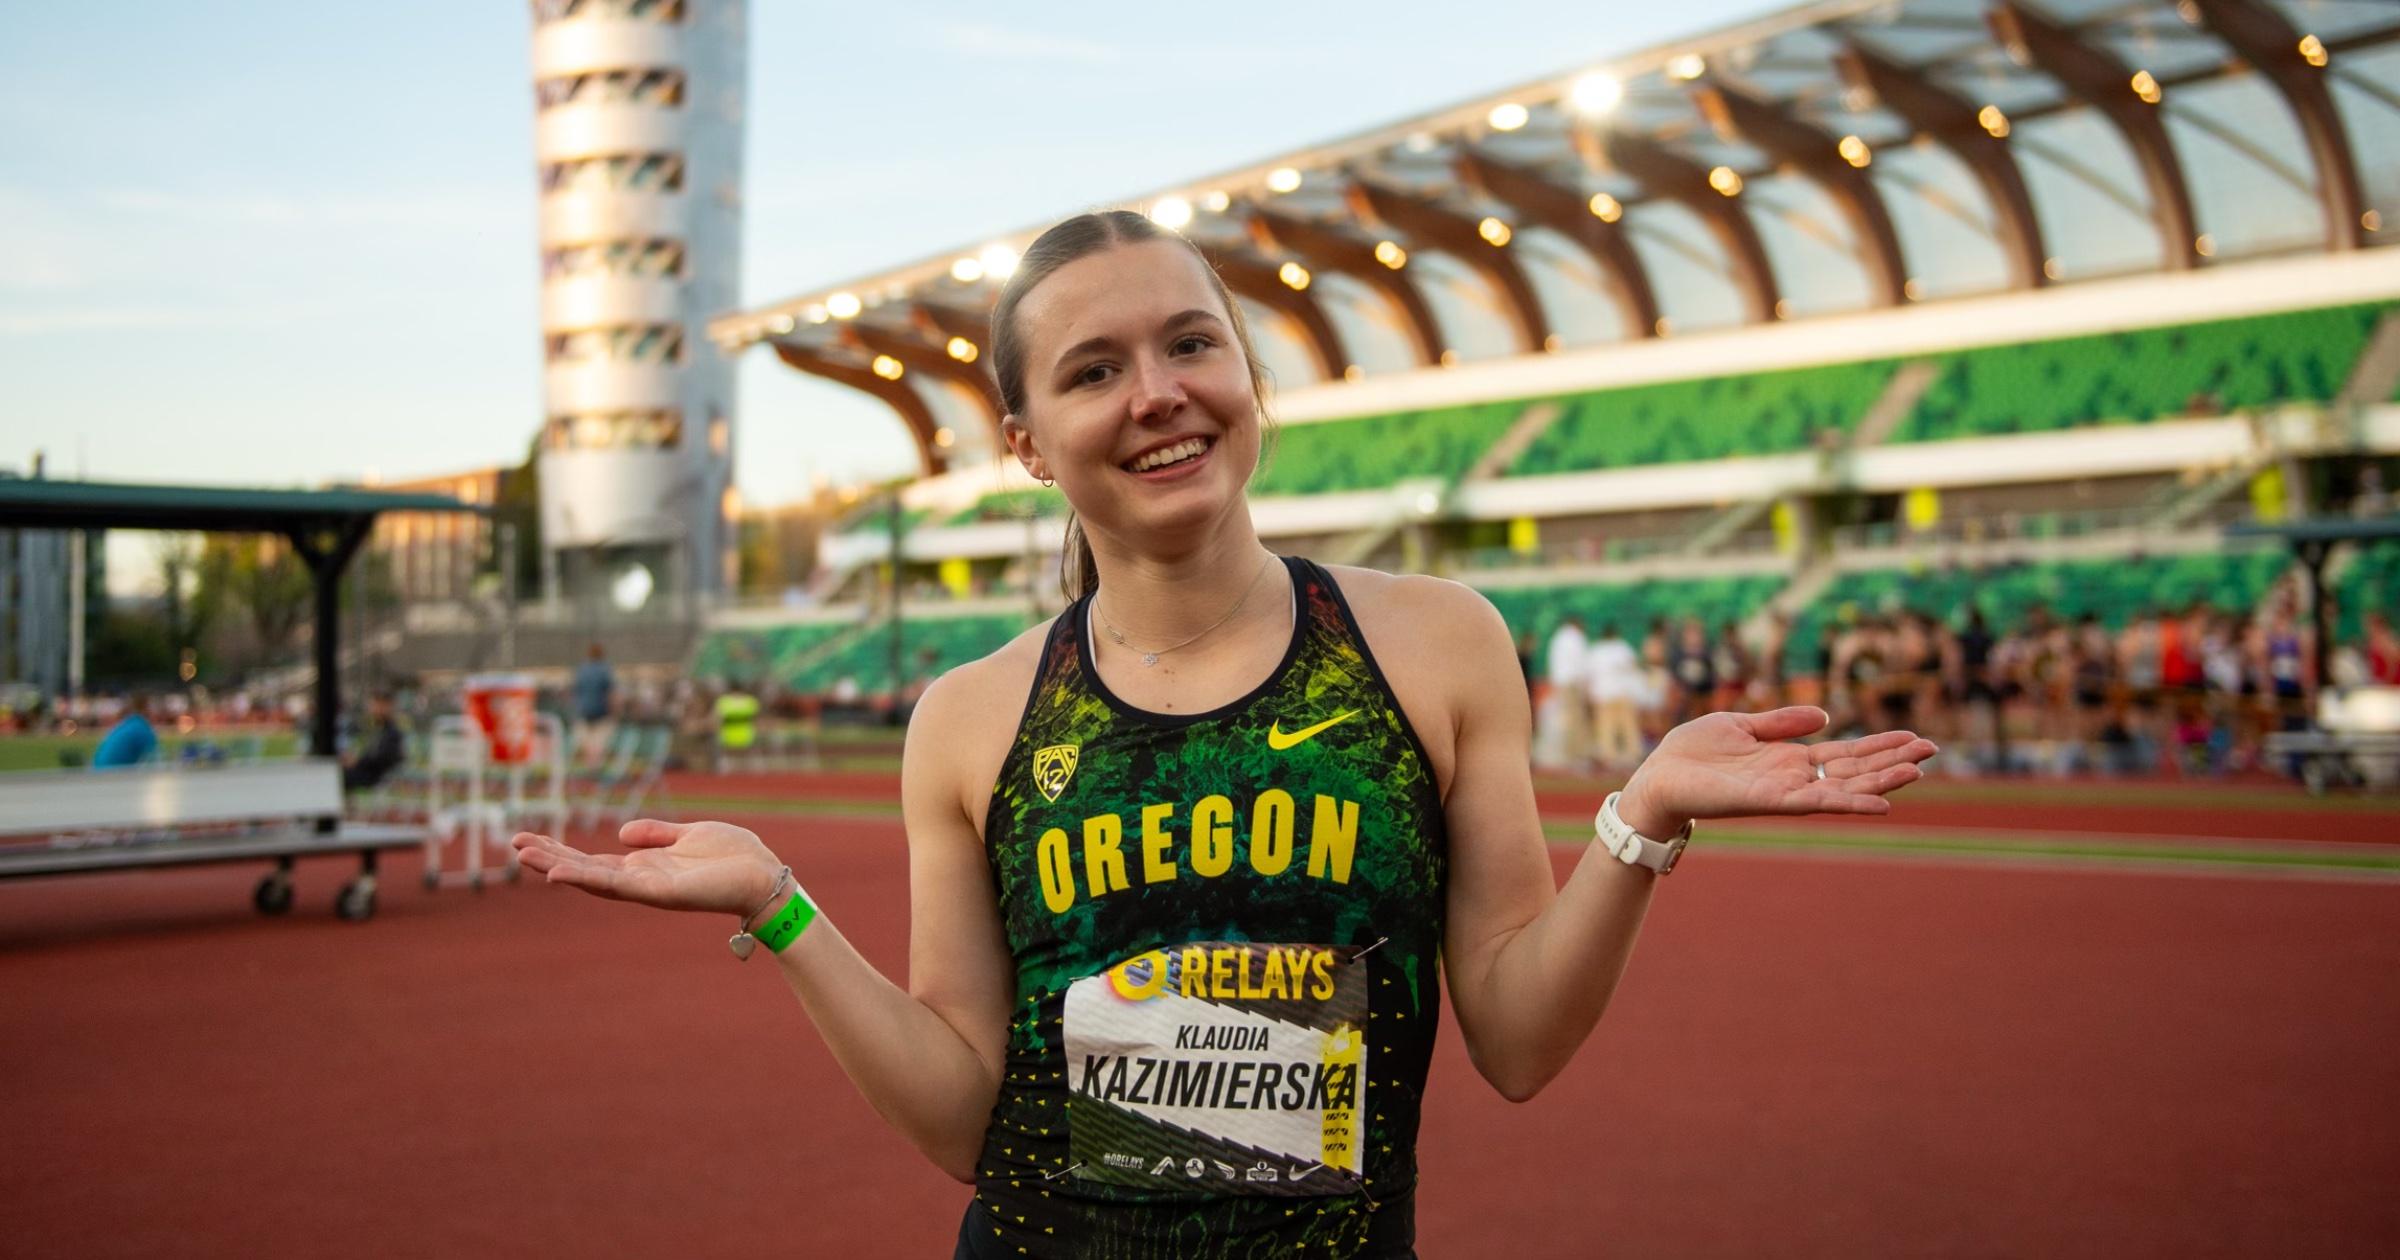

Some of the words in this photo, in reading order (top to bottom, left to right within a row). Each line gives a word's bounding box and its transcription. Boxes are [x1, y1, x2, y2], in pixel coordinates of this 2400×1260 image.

[1036, 748, 1076, 780] PAC
[1043, 769, 1064, 790] 12
[1036, 788, 1360, 914] OREGON
[1181, 948, 1335, 1001] RELAYS
[1175, 1025, 1269, 1051] KLAUDIA
[1081, 1055, 1358, 1110] KAZIMIERSKA
